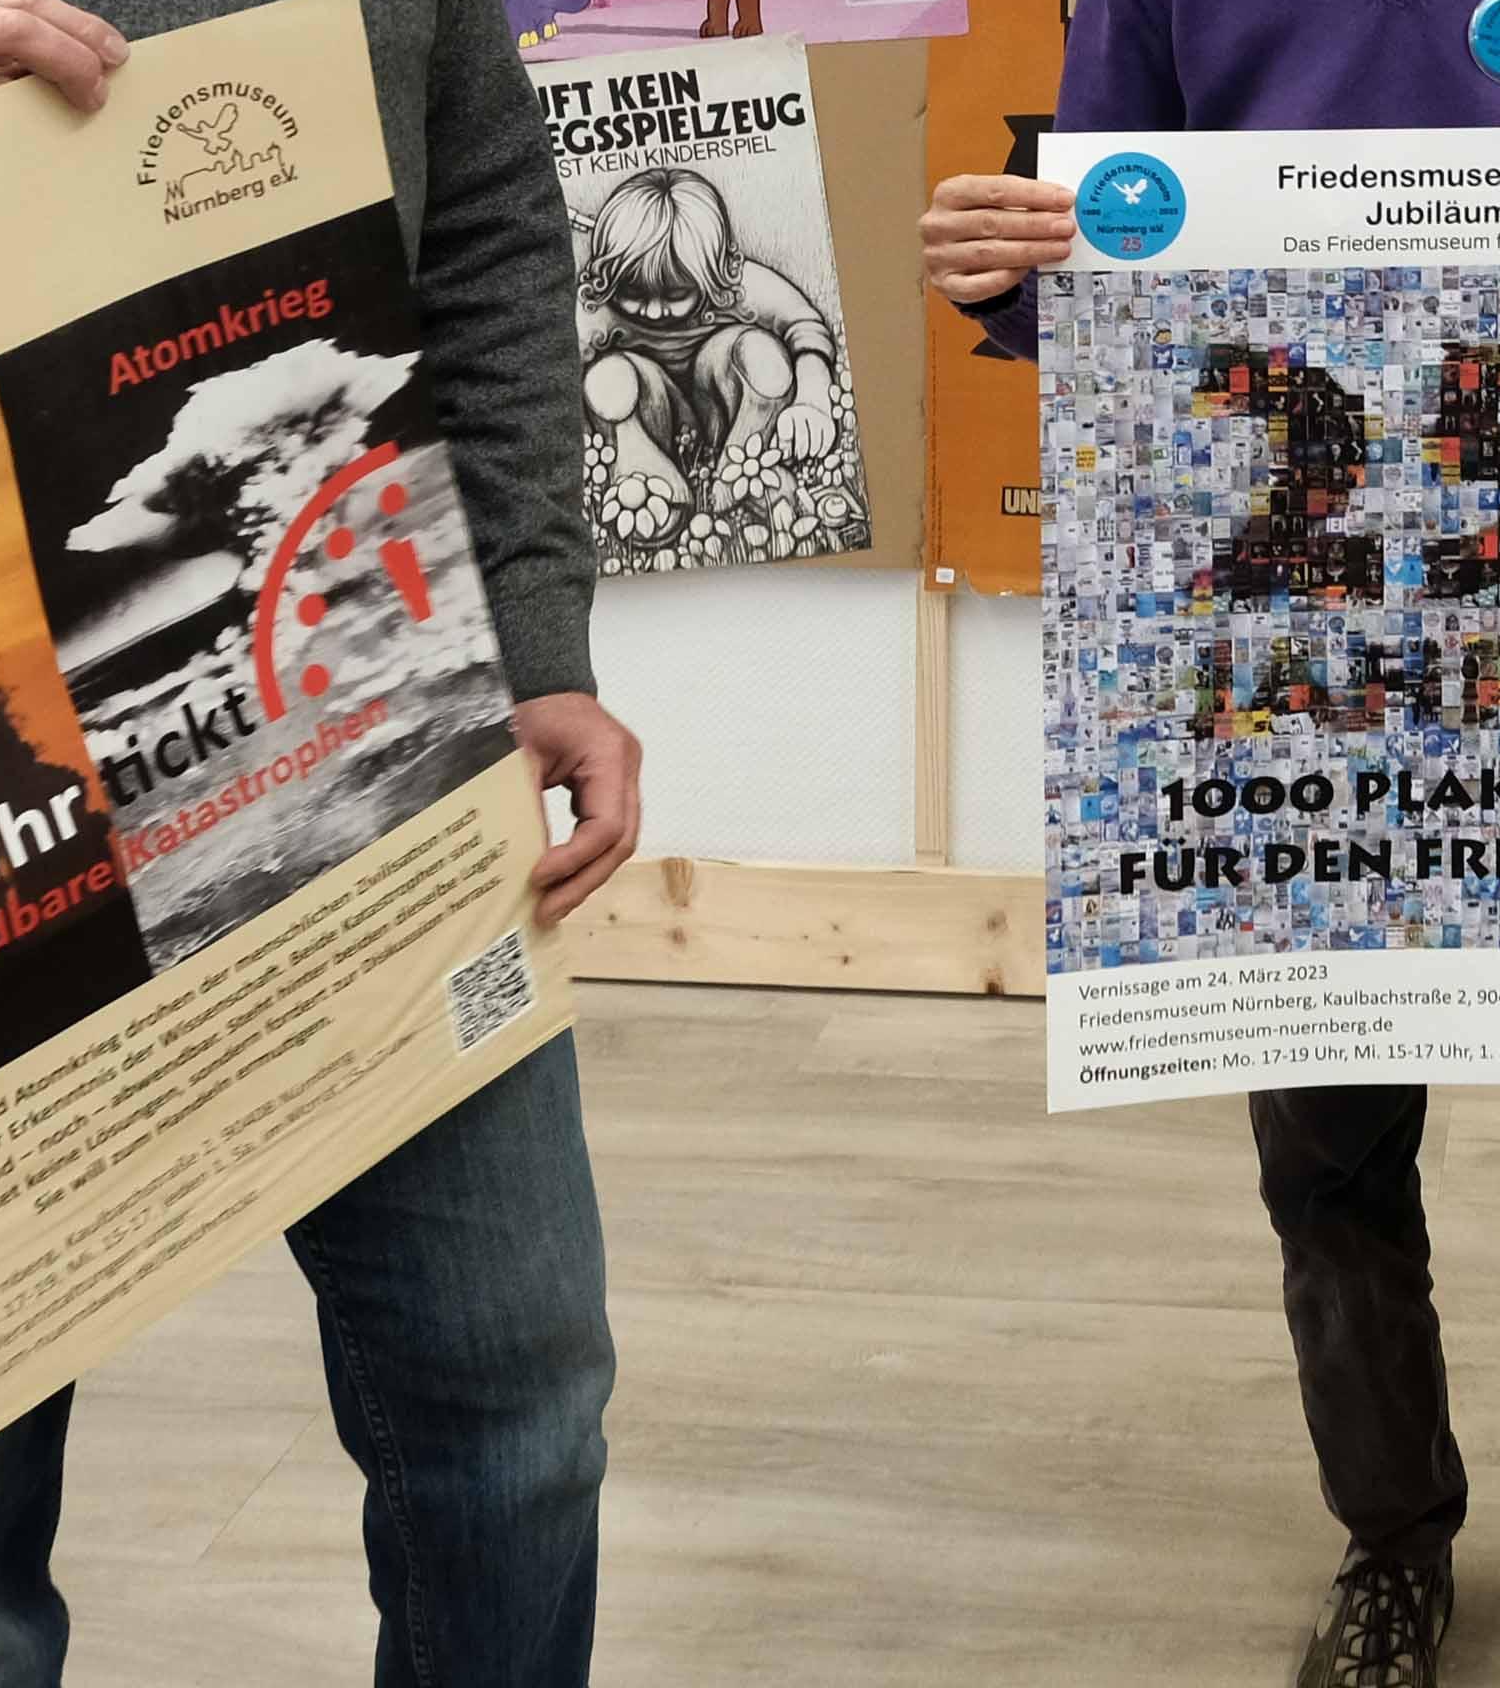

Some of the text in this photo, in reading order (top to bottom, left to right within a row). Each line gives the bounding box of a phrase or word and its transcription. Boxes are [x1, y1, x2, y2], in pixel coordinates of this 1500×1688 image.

[590, 136, 777, 173] KEIN KINDERSPIEL
[1282, 235, 1320, 254] Das
[1326, 232, 1491, 254] Friedensmuseum
[105, 276, 336, 397] Atomkrieg
[98, 690, 258, 808] tickt
[1119, 837, 1244, 896] FÜR
[1264, 838, 1393, 885] DEN
[1078, 964, 1329, 1003] Vernissage am 24. März 2023
[1078, 1016, 1394, 1057] www.friedensmuseum-nuernberg.de
